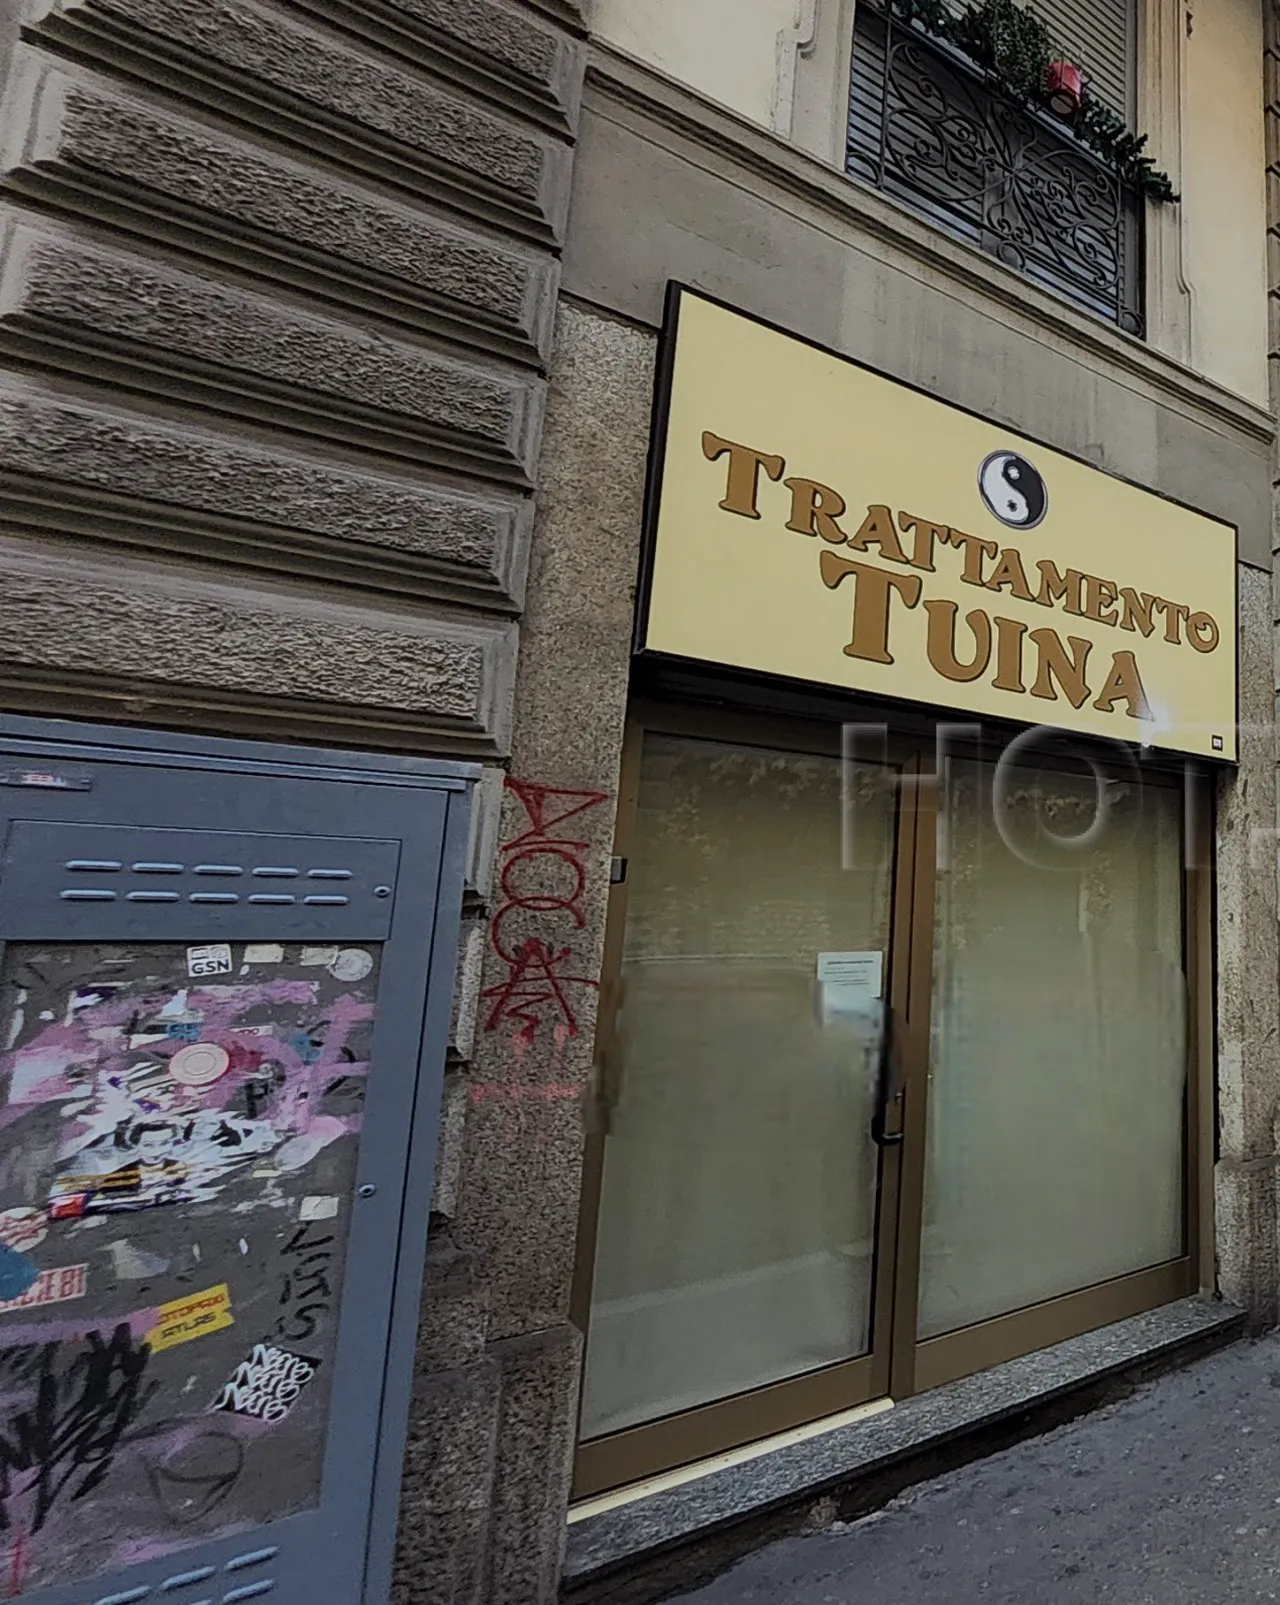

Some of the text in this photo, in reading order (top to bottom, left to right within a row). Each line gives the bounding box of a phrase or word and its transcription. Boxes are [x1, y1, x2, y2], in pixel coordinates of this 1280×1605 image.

[702, 431, 1220, 654] TRATTAMENTO
[820, 550, 1156, 722] TUINA
[191, 959, 230, 975] GSN
